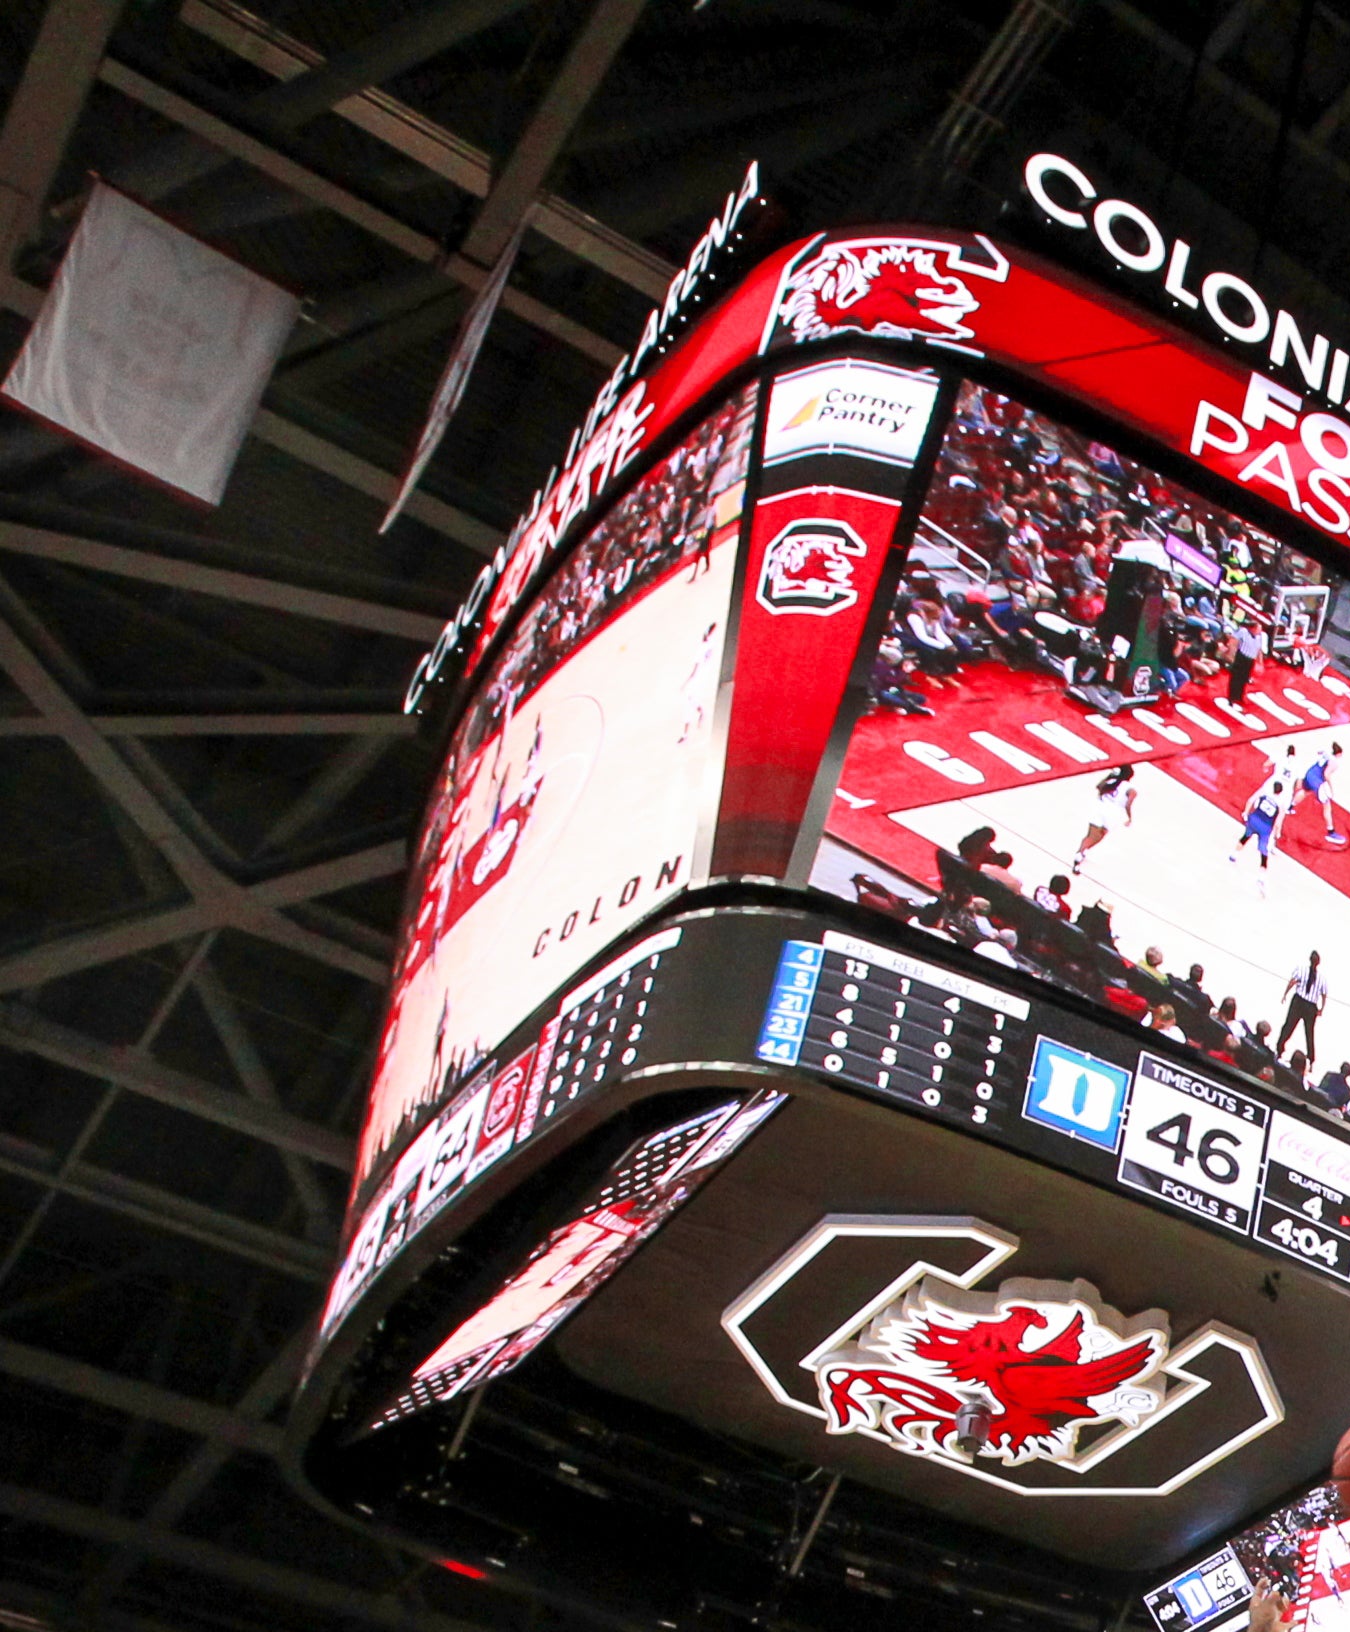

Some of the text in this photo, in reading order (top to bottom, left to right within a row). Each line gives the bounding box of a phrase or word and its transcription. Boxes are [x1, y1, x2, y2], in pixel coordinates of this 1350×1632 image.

[825, 388, 917, 415] Corner
[818, 406, 906, 434] Pantry
[798, 949, 1005, 1030] 4 13 1 4 1
[793, 972, 1003, 1054] 5 8 1 1 3
[1151, 1064, 1255, 1120] TIMEOUTS 2
[1145, 1112, 1242, 1185] 46
[1161, 1180, 1219, 1216] FOULS
[1289, 1171, 1343, 1204] QUARTER
[1302, 1197, 1322, 1220] 4
[1271, 1219, 1338, 1266] 4:04
[1215, 1568, 1236, 1592] 46
